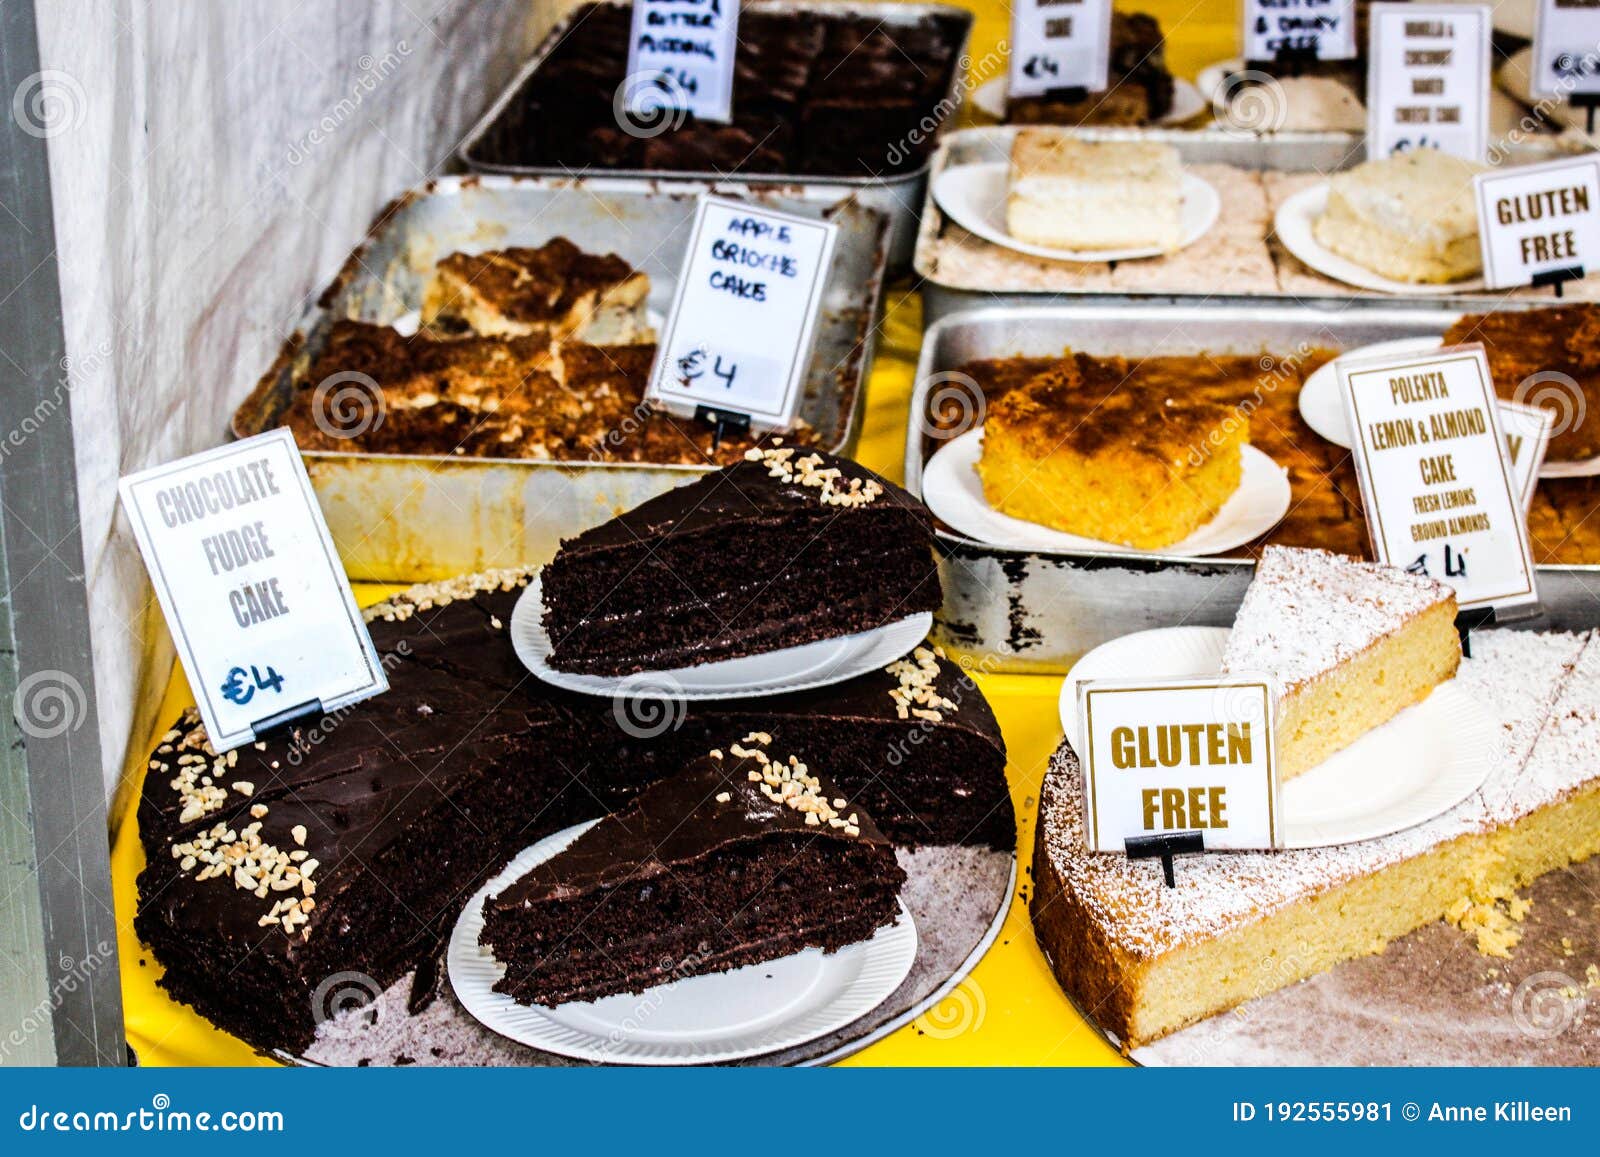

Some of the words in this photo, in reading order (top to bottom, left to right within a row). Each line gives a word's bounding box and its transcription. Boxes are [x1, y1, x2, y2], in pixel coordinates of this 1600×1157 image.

[1497, 185, 1589, 226] GLUTEN
[728, 218, 792, 244] APPLE
[1520, 230, 1577, 265] FREE
[711, 239, 798, 278] BRIOCHE
[709, 270, 767, 302] CAKE
[1389, 371, 1449, 406] POLENTA
[1369, 418, 1417, 452] LEMON
[1418, 420, 1430, 444] &
[1429, 407, 1486, 442] ALMOND
[1419, 454, 1457, 485] CAKE
[155, 458, 281, 528] CHOCOLATE
[1412, 493, 1441, 515] FRESH
[1440, 487, 1477, 510] LEMONS
[1410, 519, 1447, 543] GROUND
[1448, 512, 1490, 537] ALMONDS
[201, 521, 275, 576] FUDGE
[228, 577, 290, 629] CAKE
[220, 665, 285, 705] €4
[1111, 722, 1253, 769] GLUTEN
[1141, 786, 1229, 830] FREE
